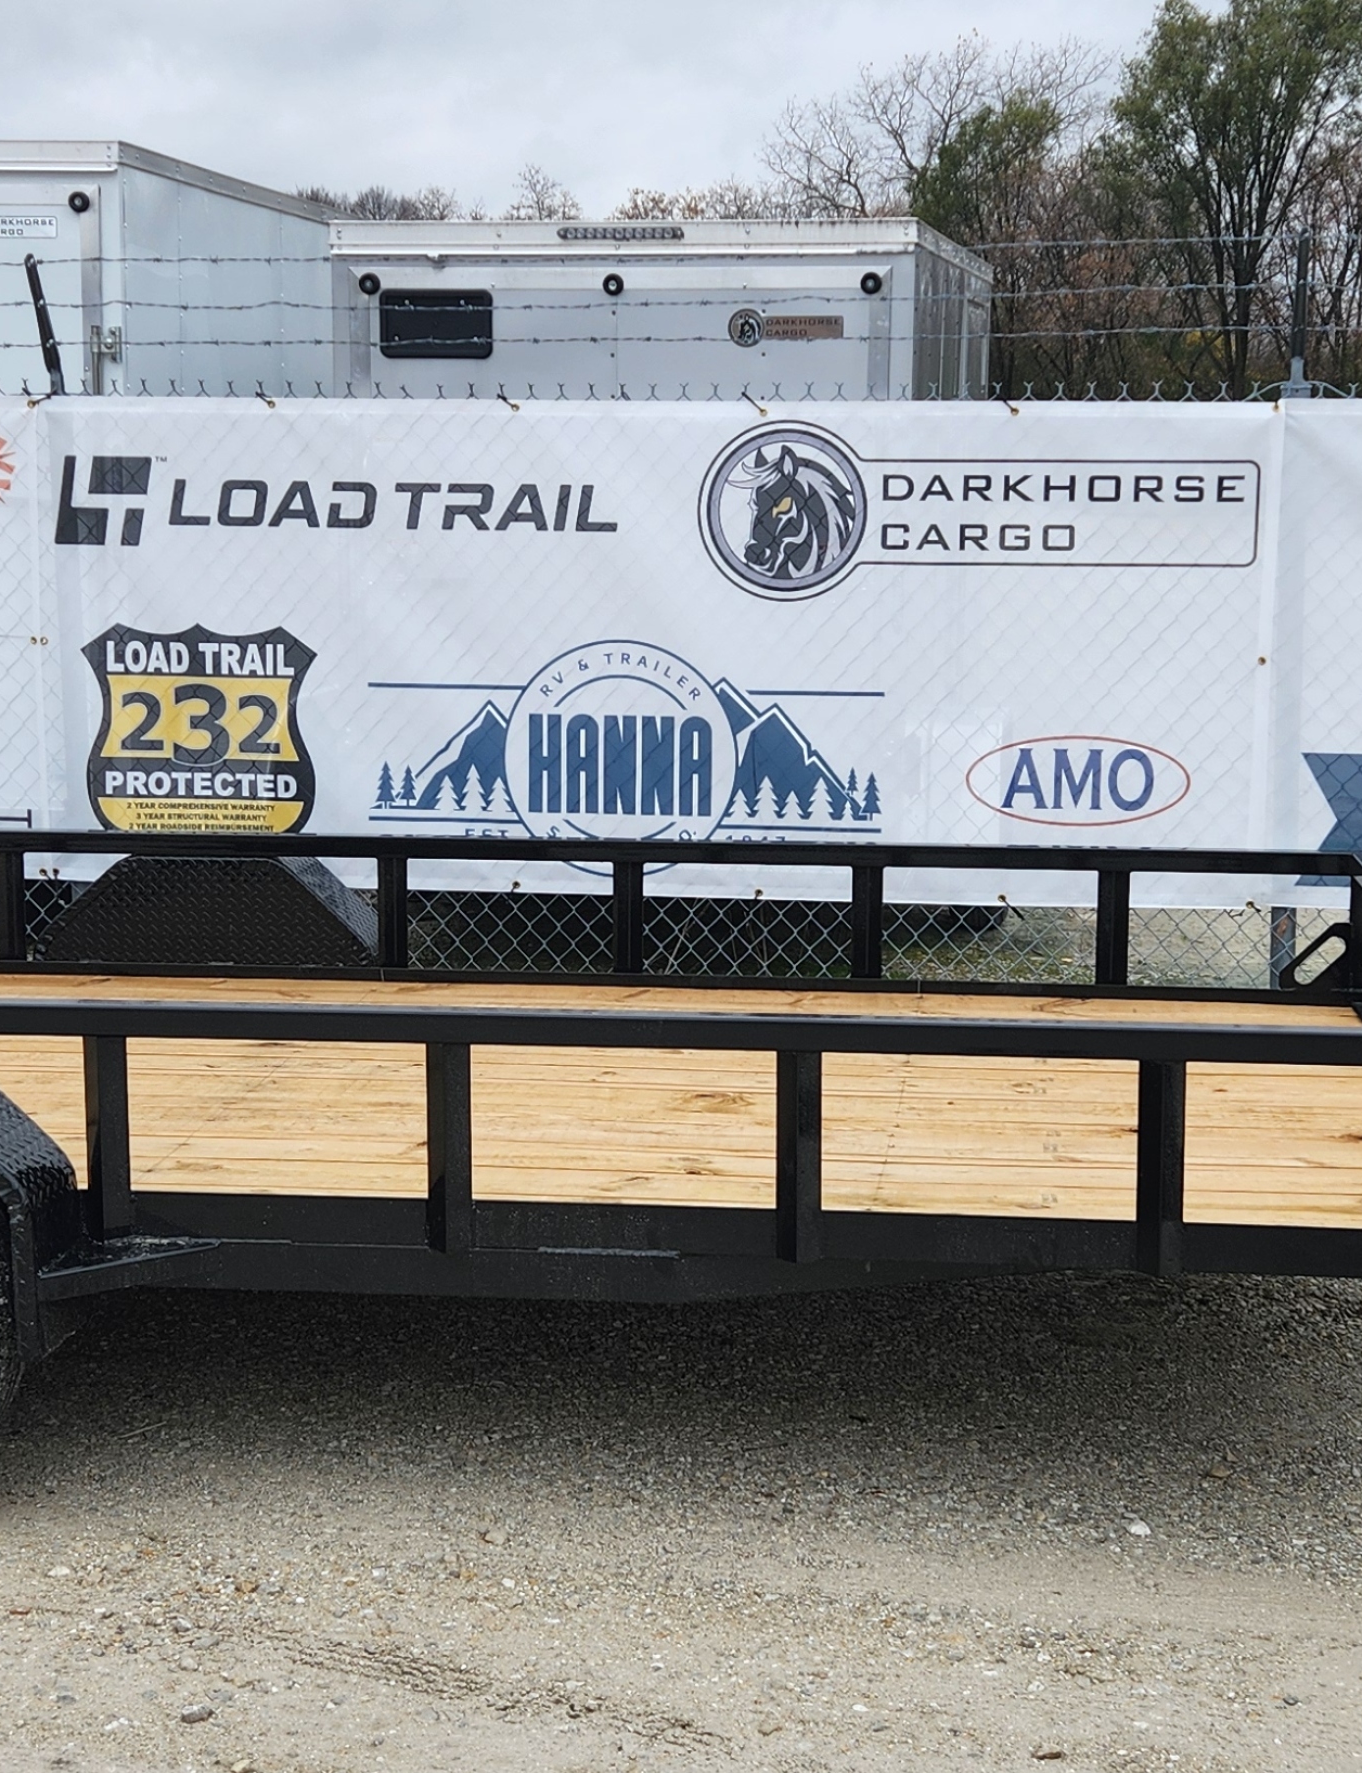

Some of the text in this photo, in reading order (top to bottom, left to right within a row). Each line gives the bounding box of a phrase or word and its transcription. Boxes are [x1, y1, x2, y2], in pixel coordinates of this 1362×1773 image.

[765, 318, 842, 327] DARKHORSE
[765, 328, 808, 337] CARGO
[882, 474, 1246, 503] DARKHORSE
[169, 479, 619, 532] LOAD TRAIL
[880, 523, 1077, 551] CARGO
[105, 640, 295, 676] LOAD TRAIL
[540, 652, 701, 701] RV & TRAILER
[121, 683, 282, 767] 232
[528, 713, 713, 817] HANNA
[1000, 747, 1155, 812] AMO
[104, 770, 298, 798] PROTECTED
[135, 802, 156, 810] YEAR
[158, 802, 229, 811] COMPREHENSIVE
[231, 803, 276, 812] WARRANTY
[136, 812, 267, 822] 3 YEAR STRUCTURAL WARRANTY
